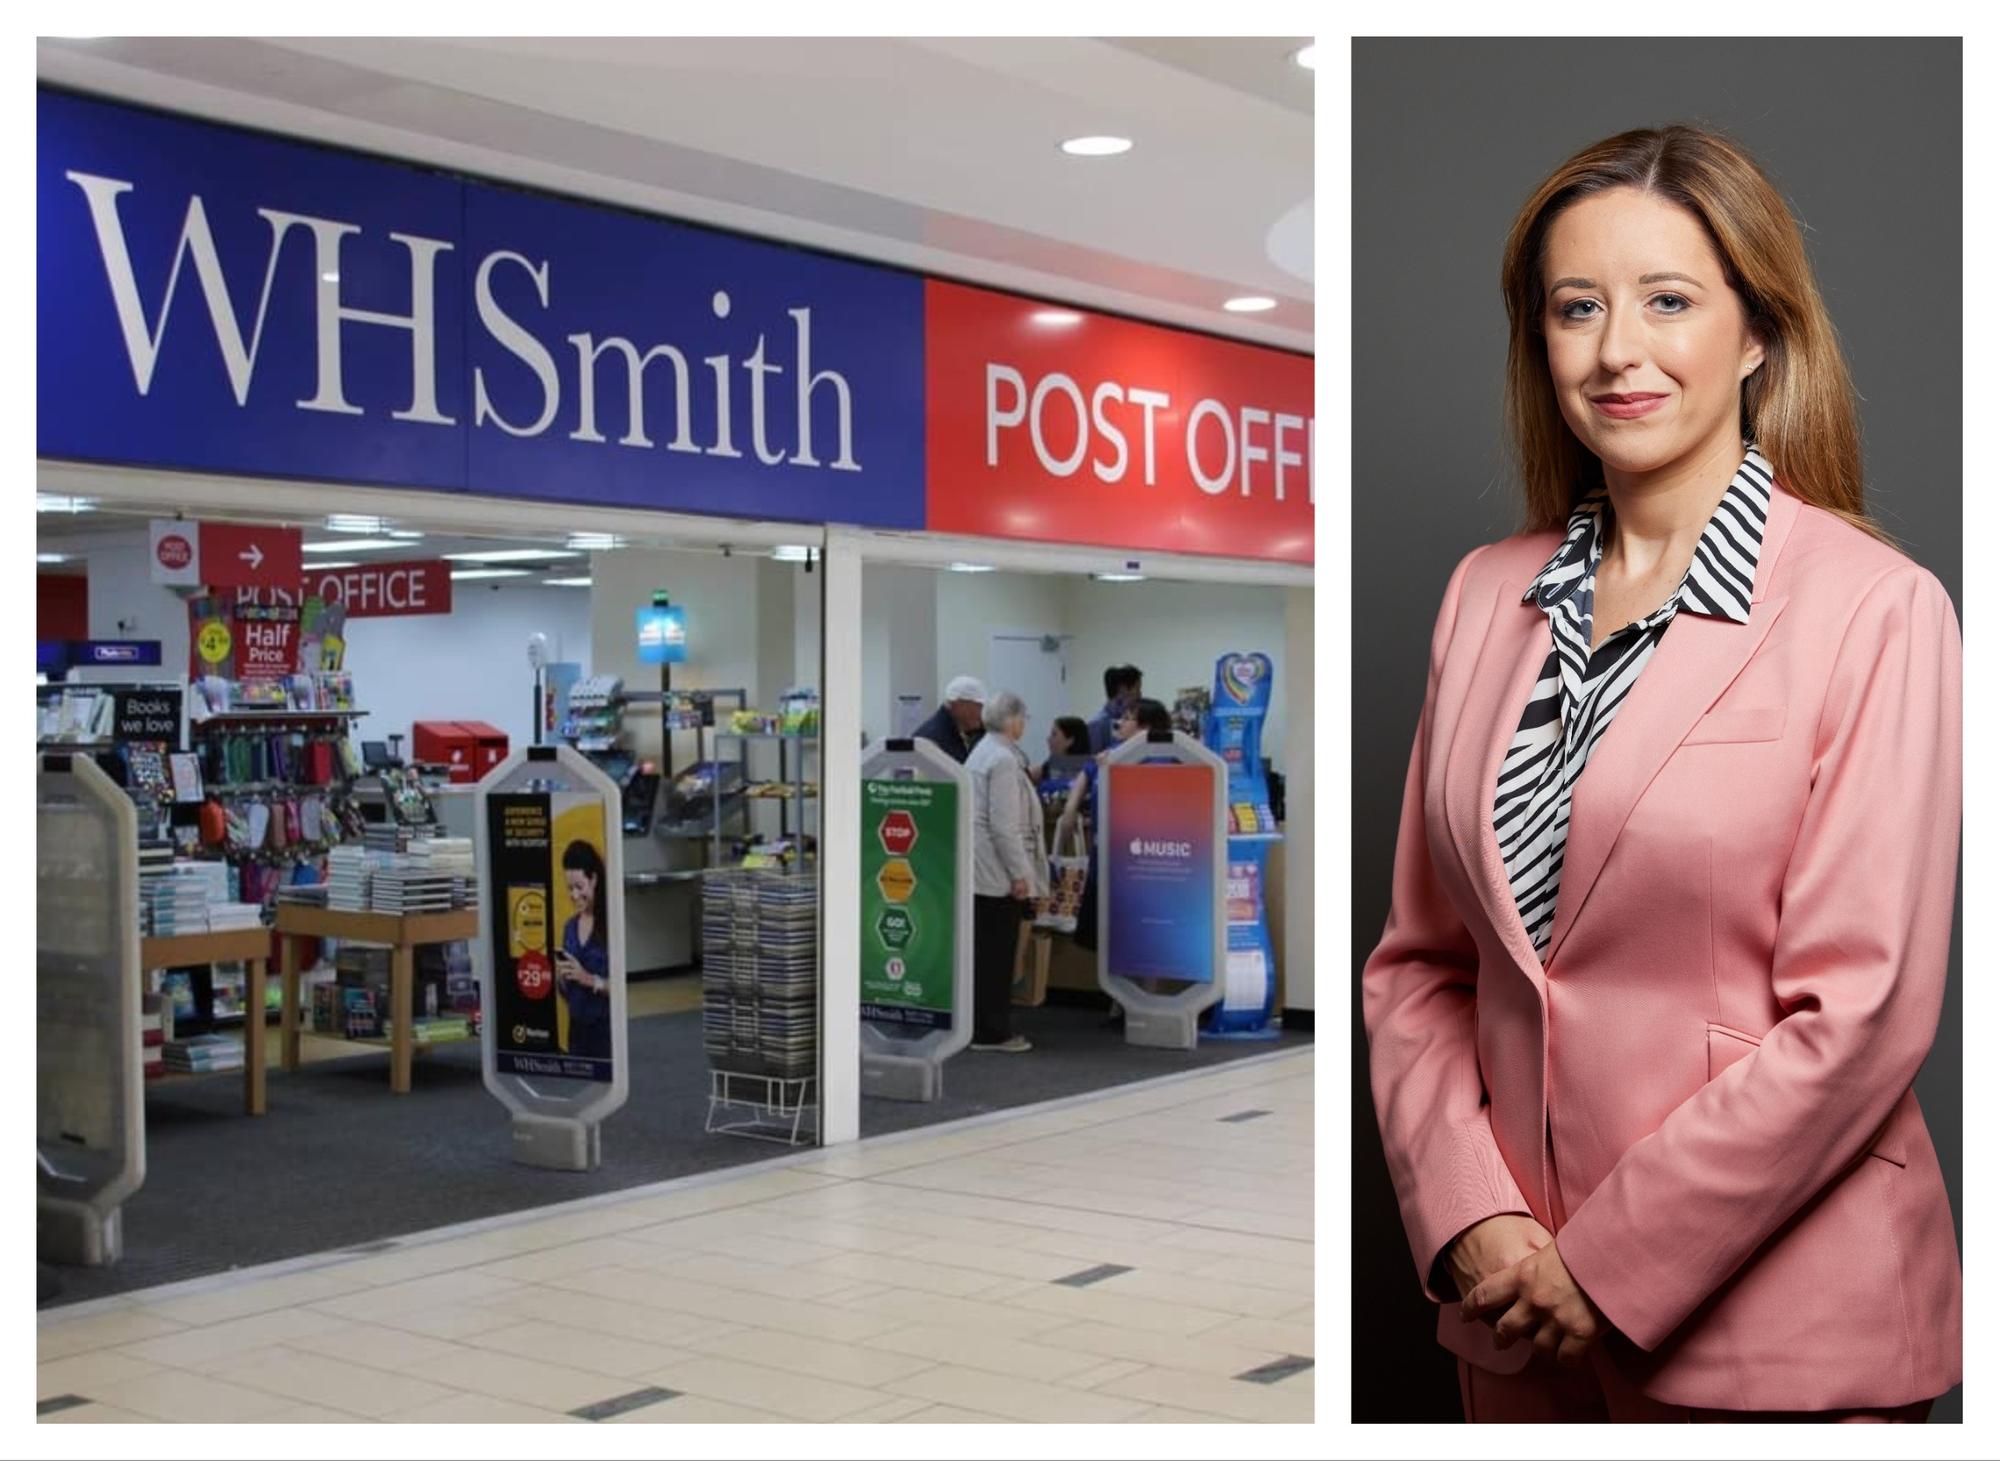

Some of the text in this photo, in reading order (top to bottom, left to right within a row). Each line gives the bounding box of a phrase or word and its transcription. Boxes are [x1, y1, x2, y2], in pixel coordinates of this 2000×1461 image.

[65, 169, 863, 472] WHSmith
[986, 363, 1169, 486] POST
[319, 569, 425, 610] OFFICE
[246, 624, 291, 647] Half
[250, 647, 284, 662] Price
[127, 698, 171, 714] Books
[121, 717, 174, 732] we love
[885, 827, 911, 837] STOP
[1144, 841, 1192, 857] MUSIC
[514, 1056, 561, 1073] WHSmith
